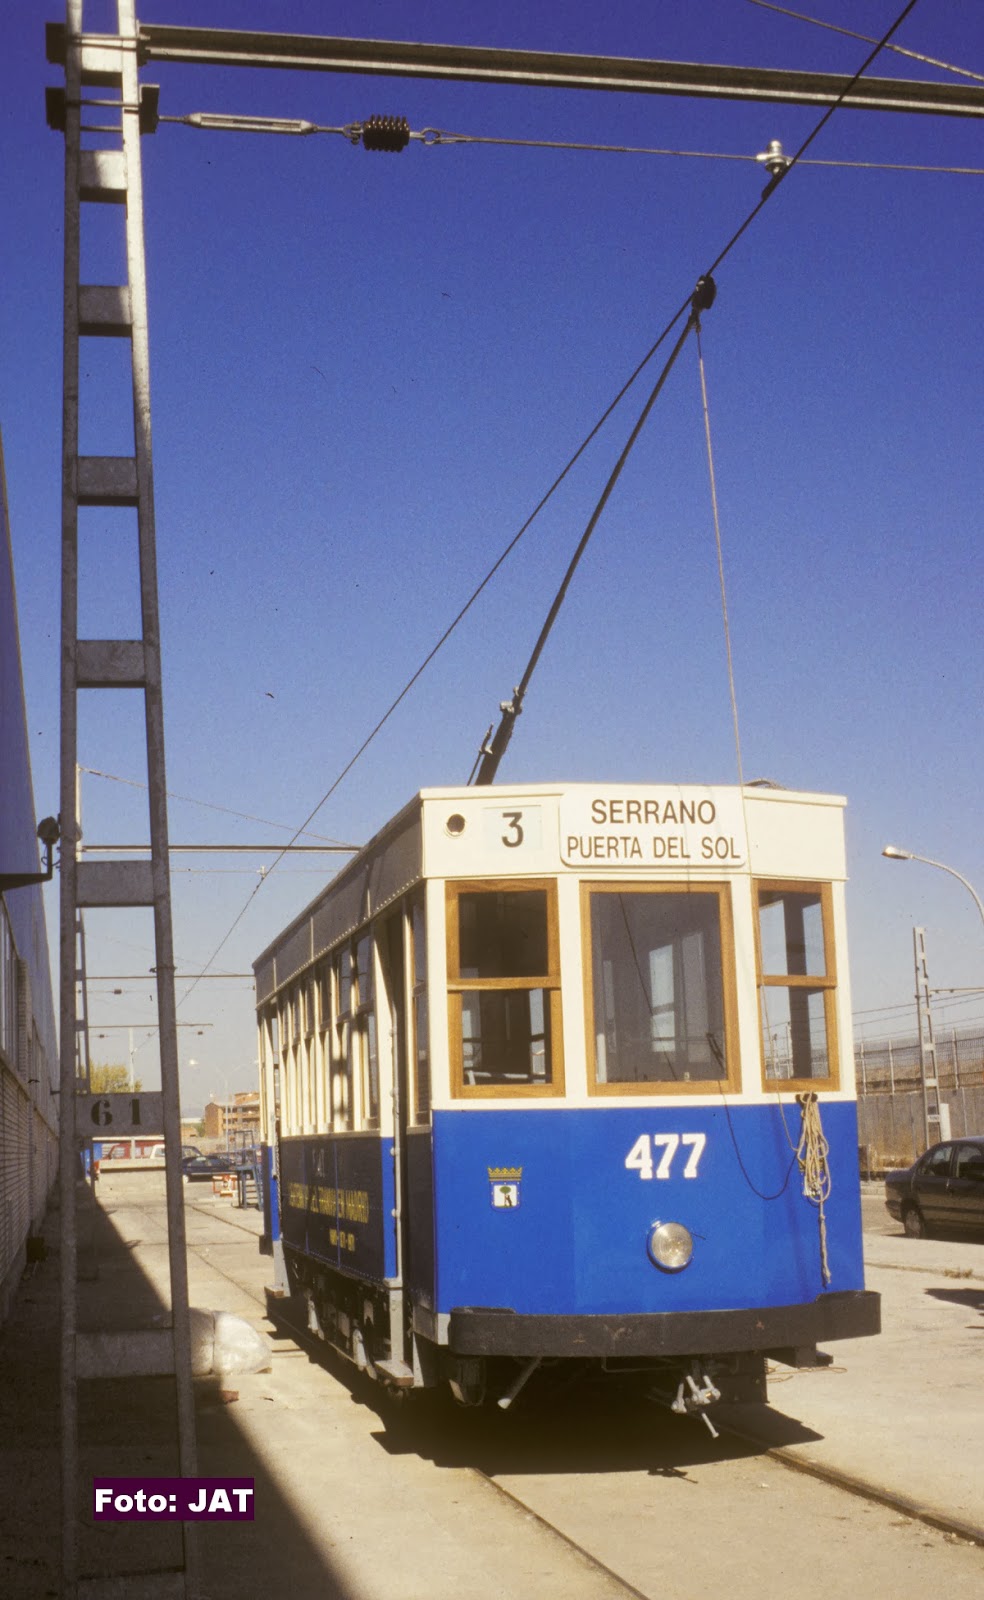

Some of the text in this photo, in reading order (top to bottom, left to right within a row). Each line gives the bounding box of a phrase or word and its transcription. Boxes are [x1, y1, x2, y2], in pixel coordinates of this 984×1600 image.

[591, 799, 717, 825] SERRANO
[501, 811, 524, 848] 3
[567, 836, 741, 860] PUERTA DEL SOL
[90, 1099, 142, 1127] 61
[624, 1132, 707, 1180] 477
